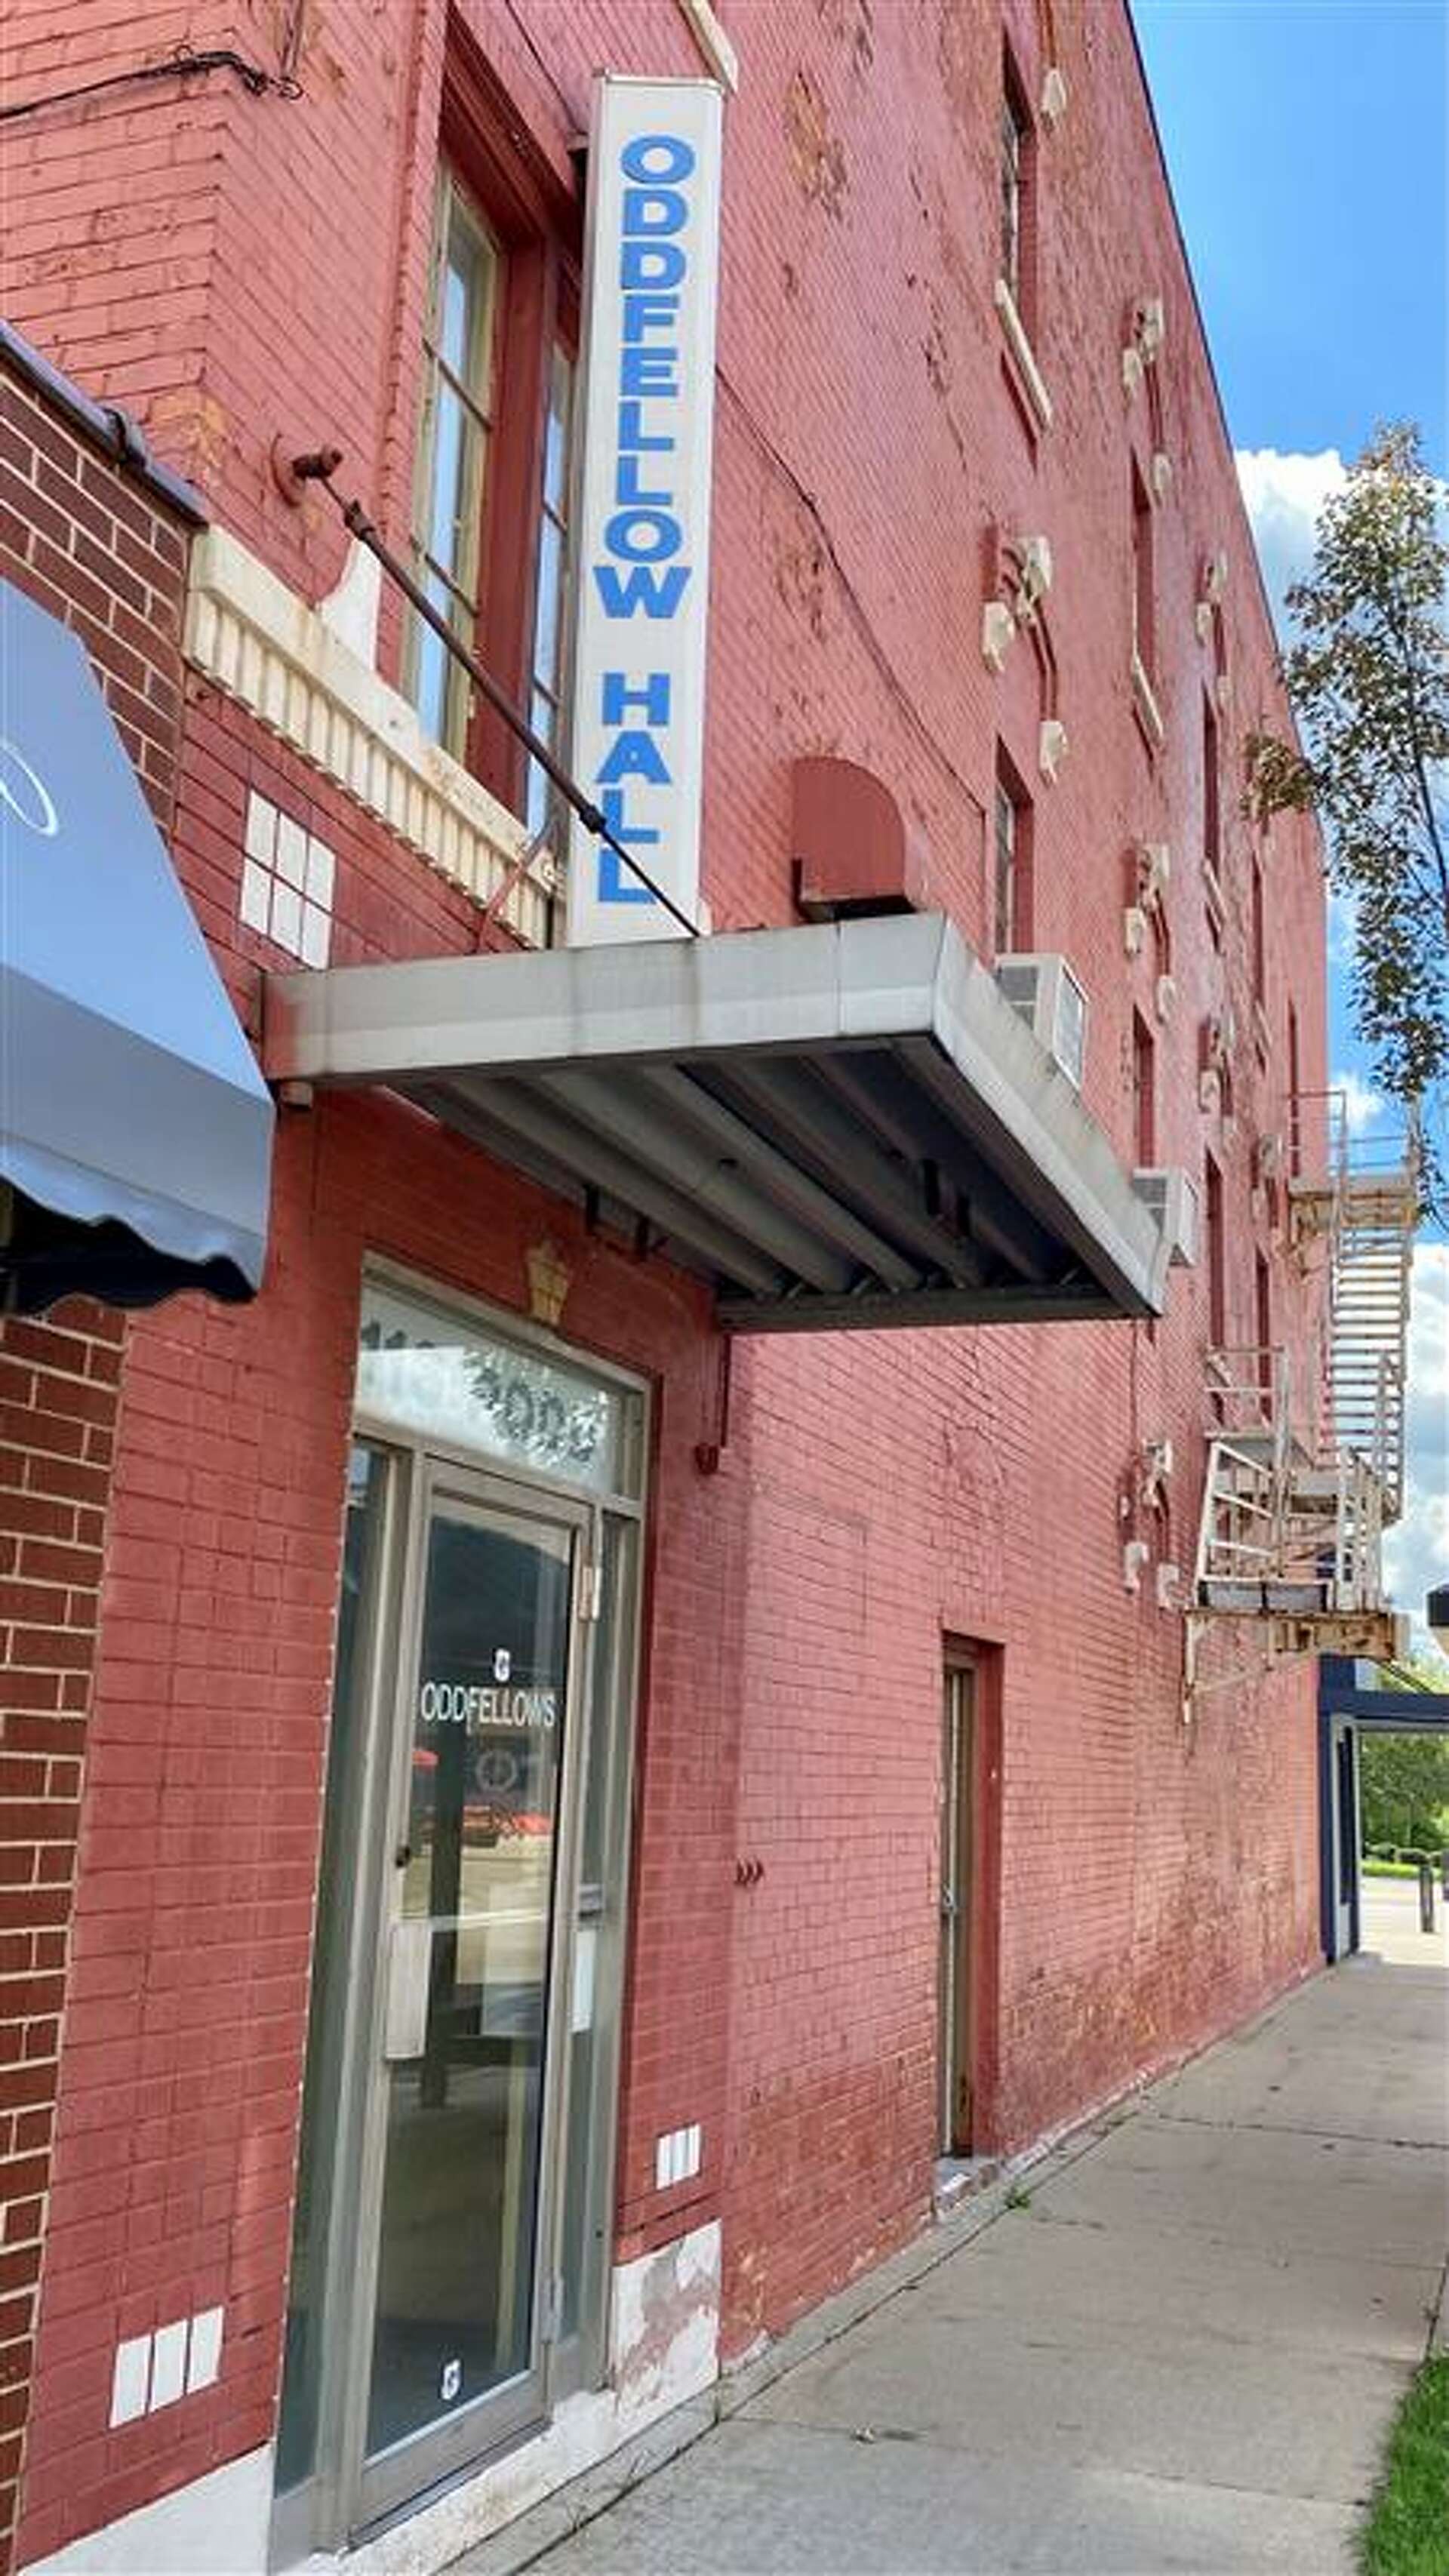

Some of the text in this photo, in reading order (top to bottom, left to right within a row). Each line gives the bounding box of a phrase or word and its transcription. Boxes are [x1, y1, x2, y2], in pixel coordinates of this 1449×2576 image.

[594, 135, 696, 902] ODDFELLOW HALL
[420, 1683, 556, 1728] ODDFELLOWS
